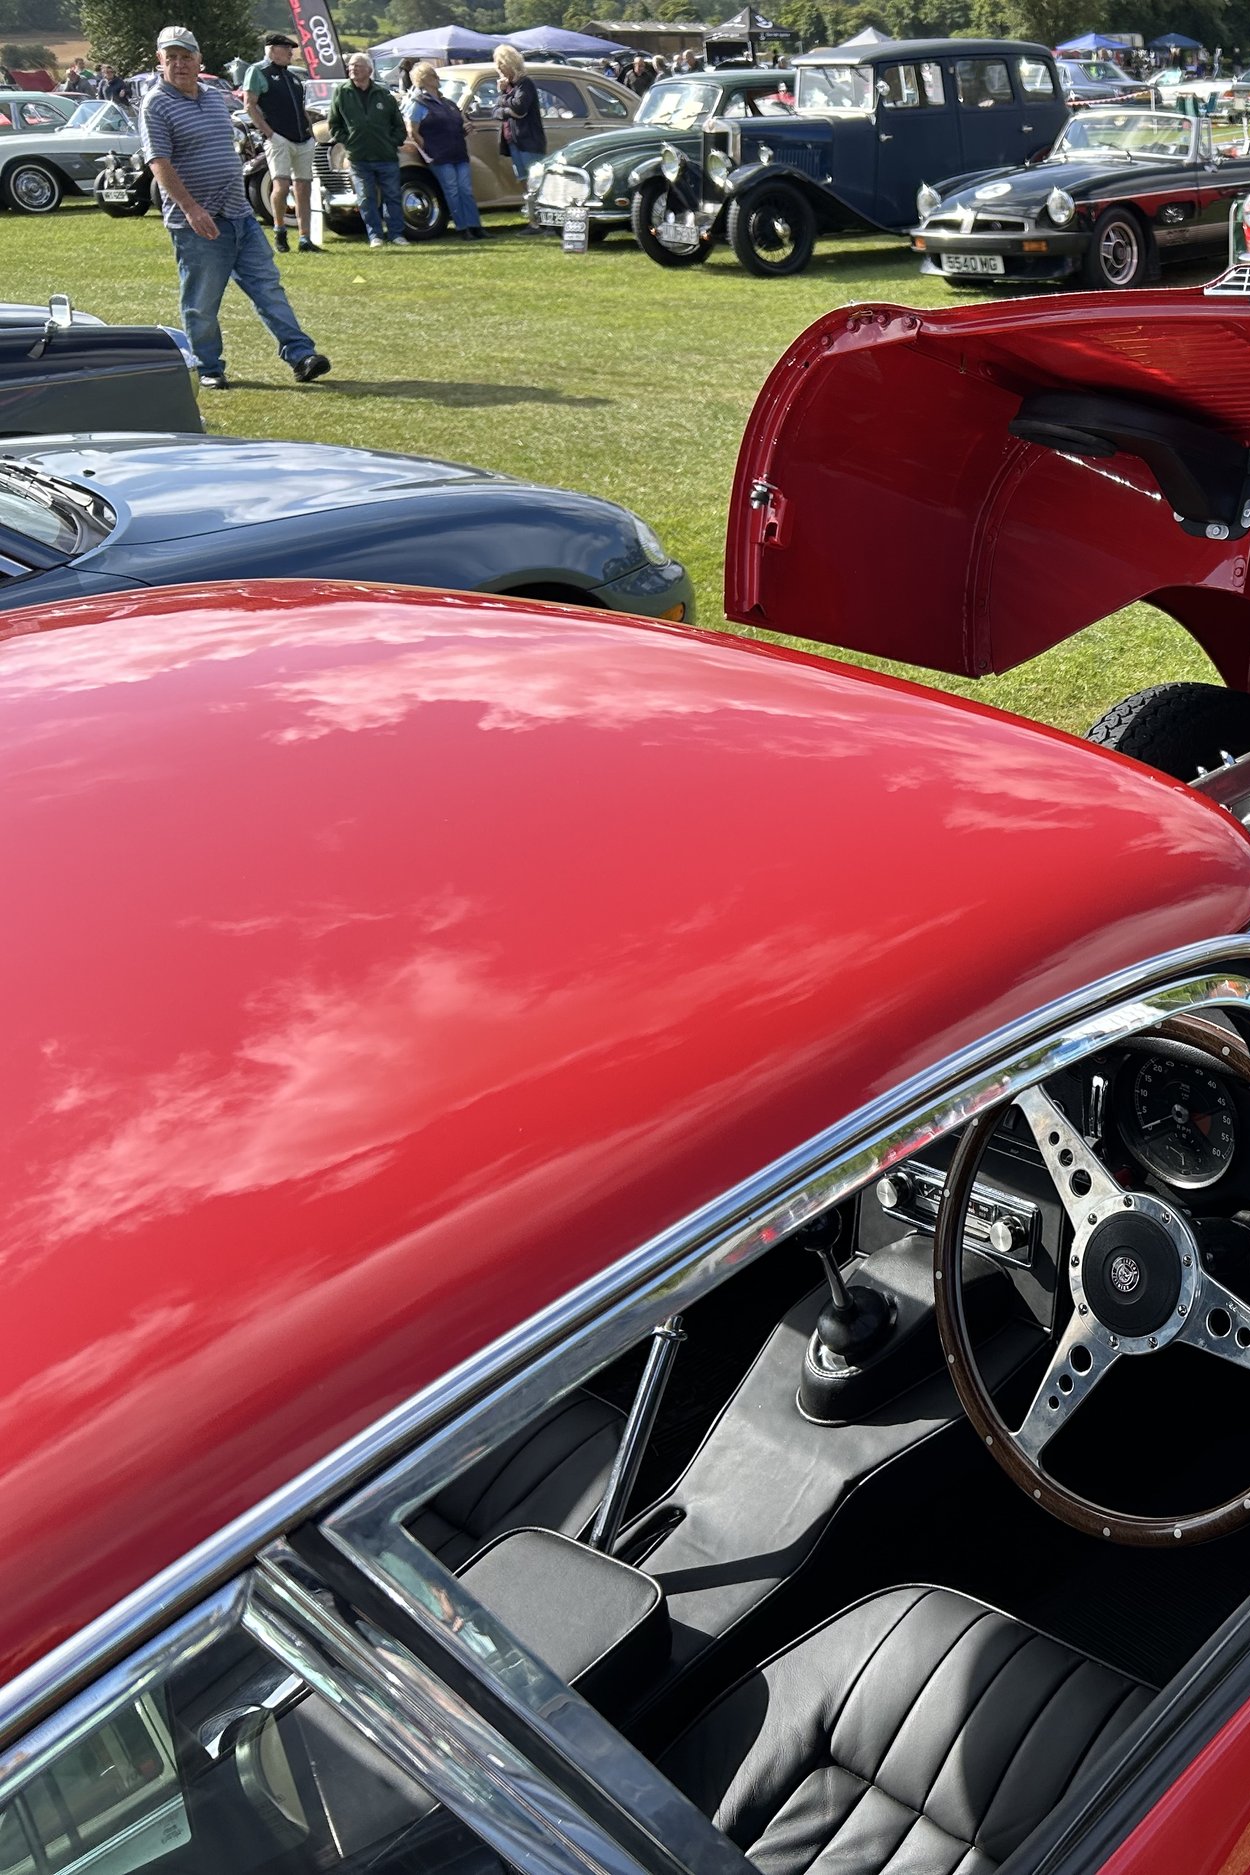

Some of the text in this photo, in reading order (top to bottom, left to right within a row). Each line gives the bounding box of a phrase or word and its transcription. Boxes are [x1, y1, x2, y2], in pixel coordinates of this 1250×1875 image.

[1152, 1063, 1163, 1073] 20
[1144, 1074, 1153, 1083] 15
[1207, 1080, 1217, 1090] 40
[1140, 1088, 1148, 1097] 10
[1217, 1096, 1227, 1107] 45
[1142, 1106, 1148, 1114] 5
[1222, 1115, 1232, 1125] 50
[1176, 1123, 1192, 1134] RPM
[1221, 1132, 1230, 1143] 55
[1211, 1147, 1221, 1157] 60
